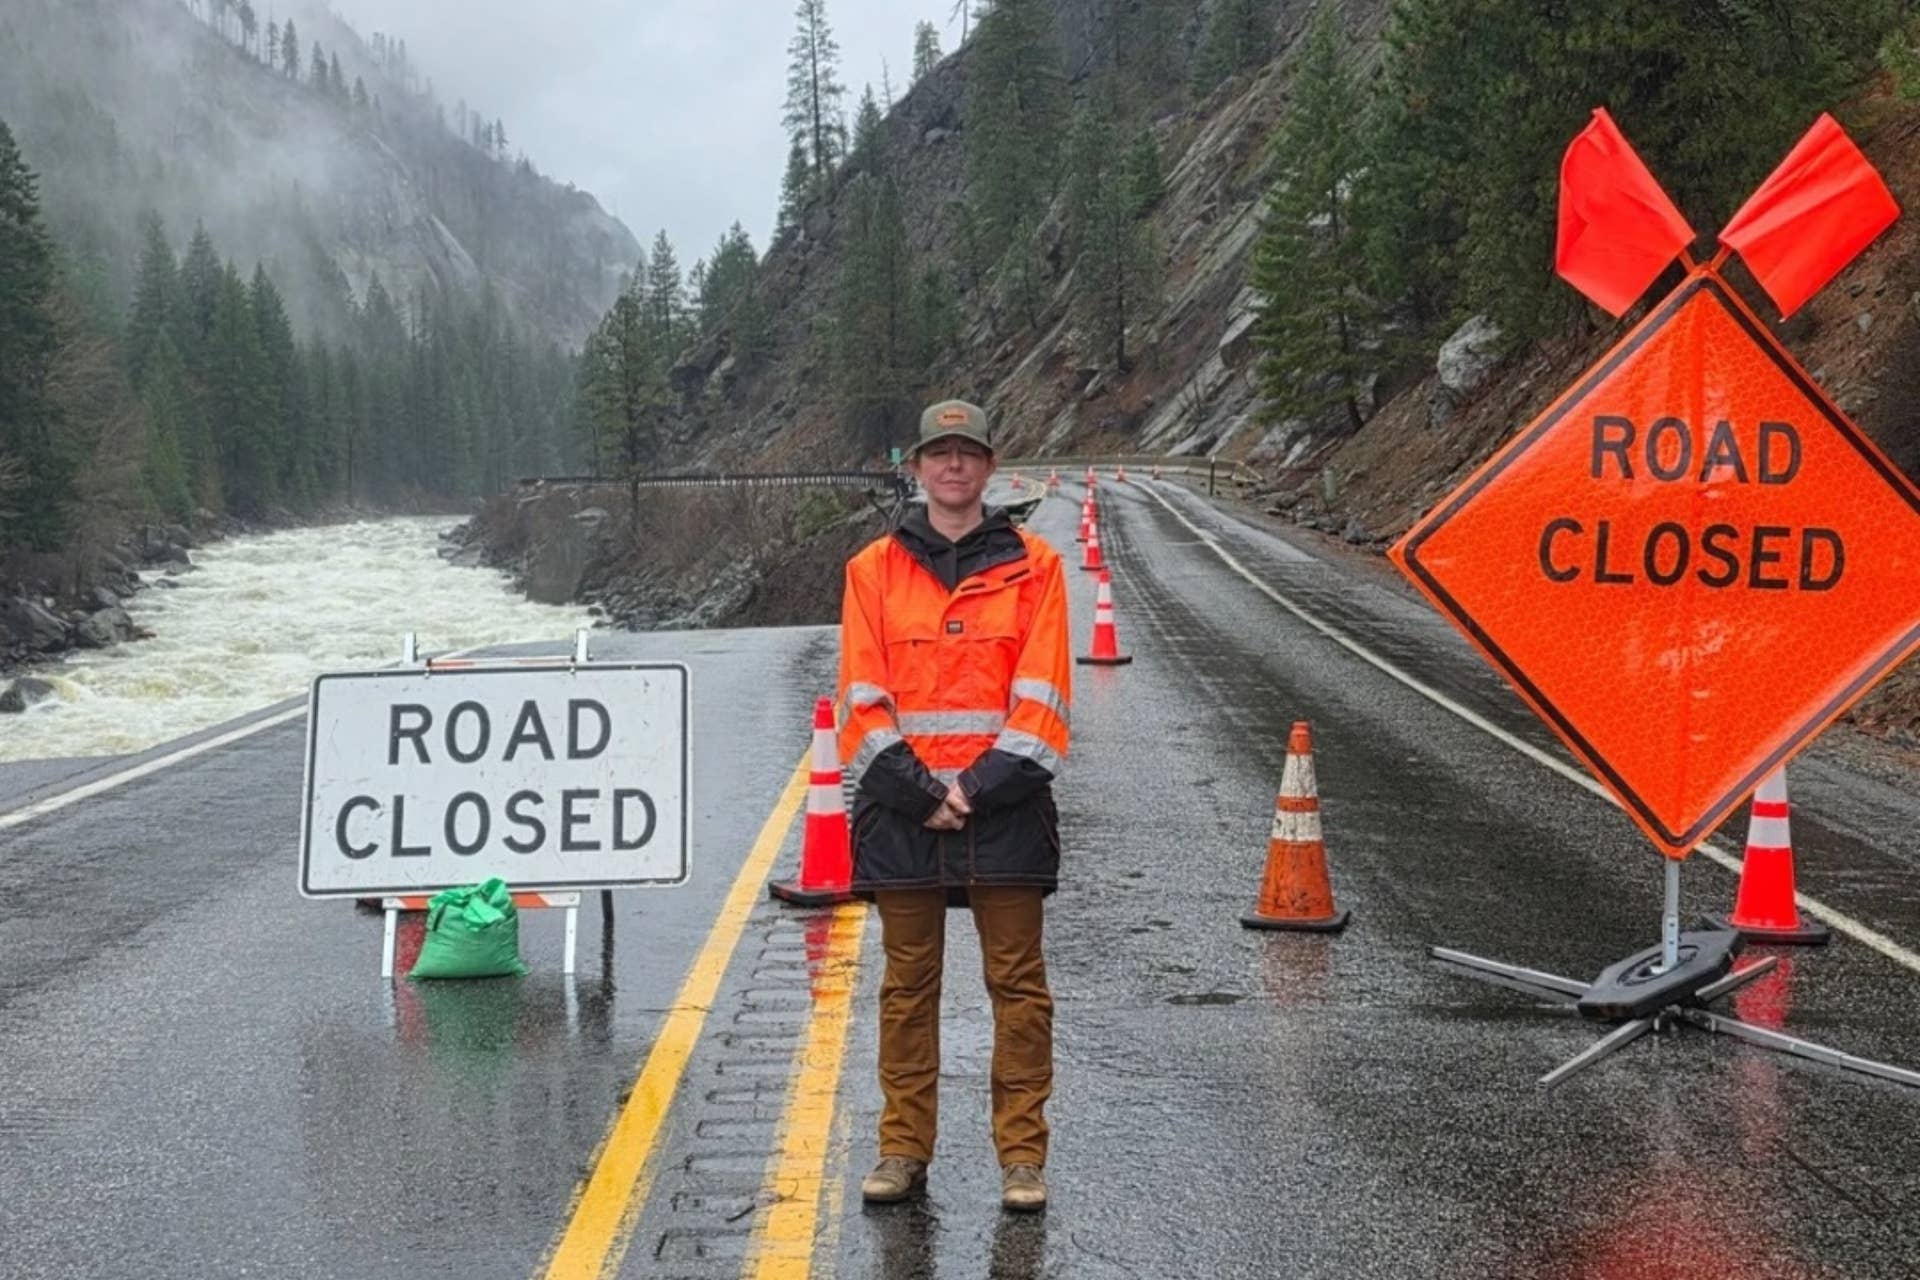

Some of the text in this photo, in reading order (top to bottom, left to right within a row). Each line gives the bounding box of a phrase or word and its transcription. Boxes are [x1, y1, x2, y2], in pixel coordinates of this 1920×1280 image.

[1590, 415, 1803, 486] ROAD
[1538, 517, 1846, 592] CLOSED
[388, 698, 612, 765] ROAD
[335, 788, 657, 860] CLOSED
